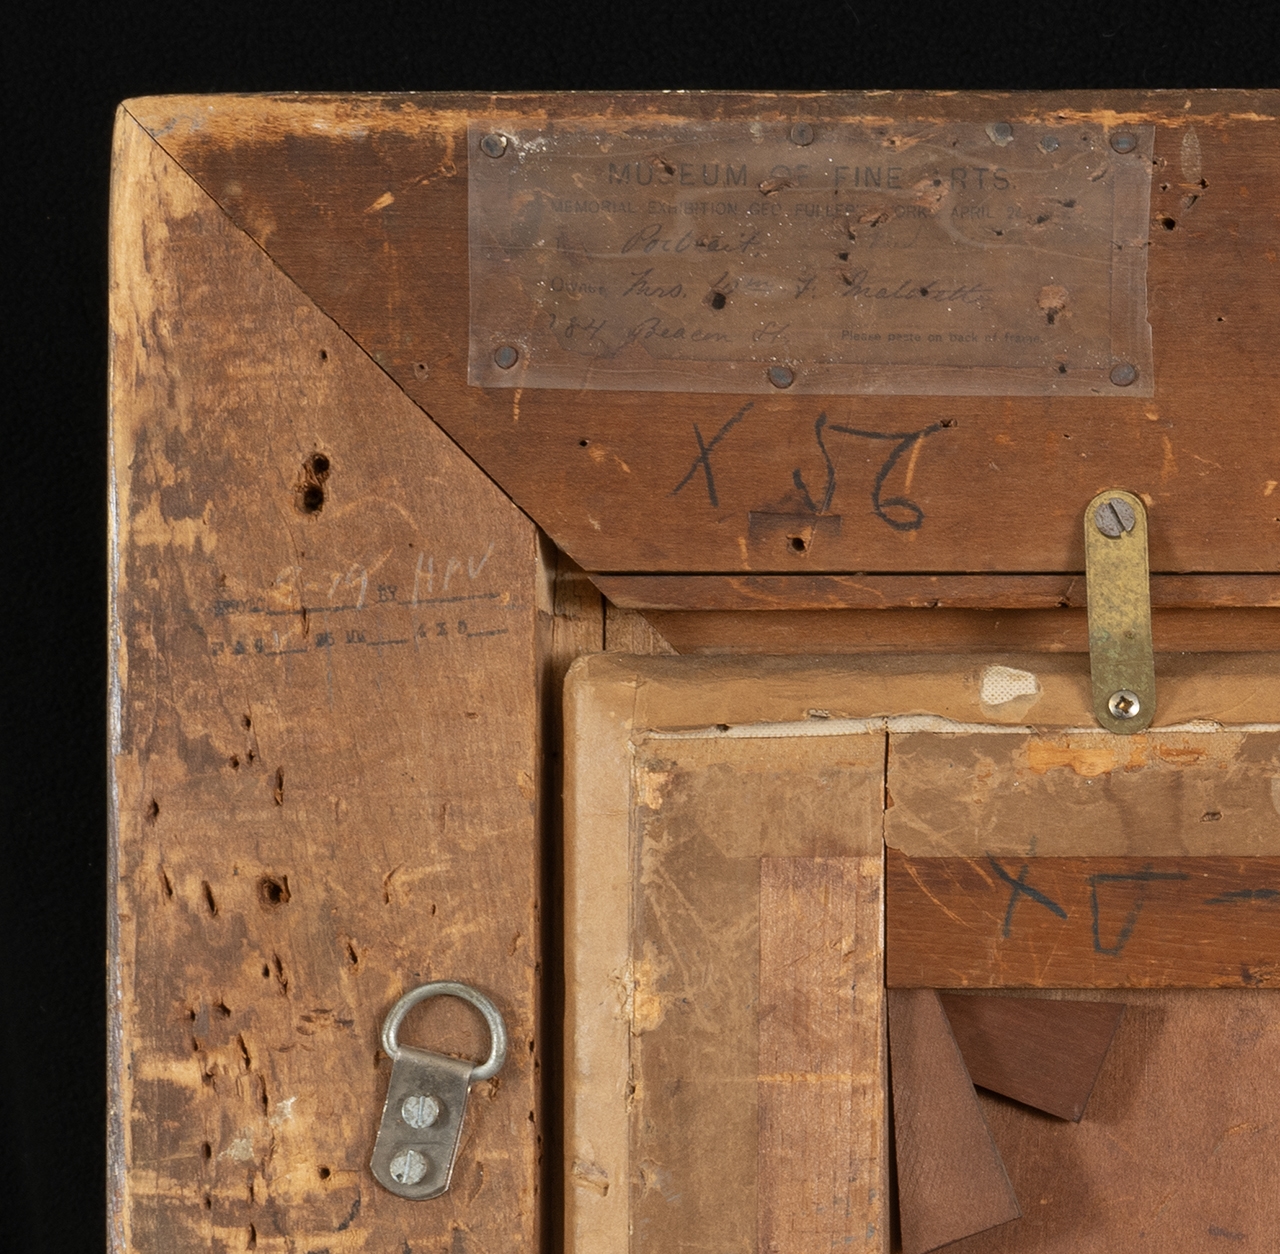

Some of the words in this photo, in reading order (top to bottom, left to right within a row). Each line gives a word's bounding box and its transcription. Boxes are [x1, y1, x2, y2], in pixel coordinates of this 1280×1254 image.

[834, 165, 903, 189] FINE
[950, 167, 1017, 191] RTS.
[928, 333, 943, 342] on
